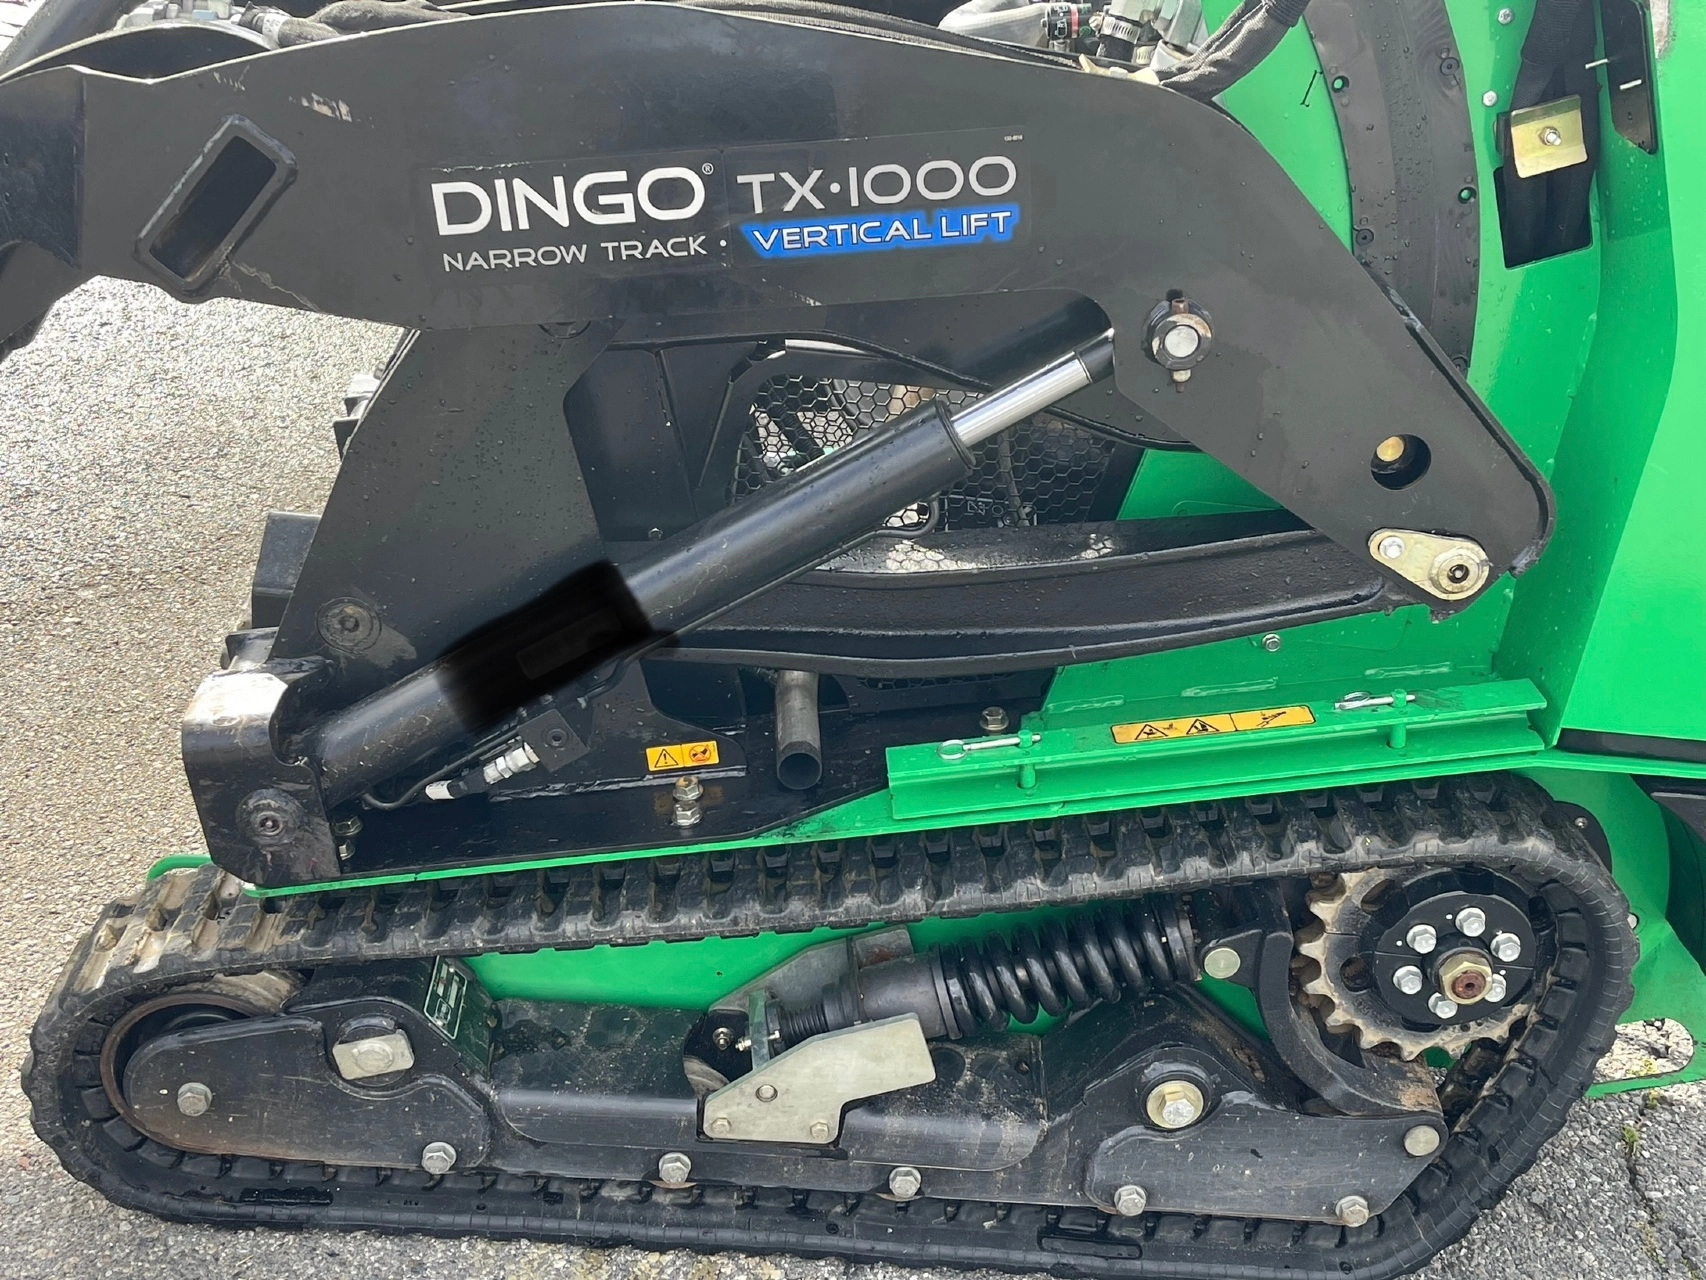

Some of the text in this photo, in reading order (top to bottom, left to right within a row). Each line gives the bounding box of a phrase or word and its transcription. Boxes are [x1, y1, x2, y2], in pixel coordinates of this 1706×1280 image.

[443, 211, 1012, 272] NARROW TRACK VERTICAL LIFT
